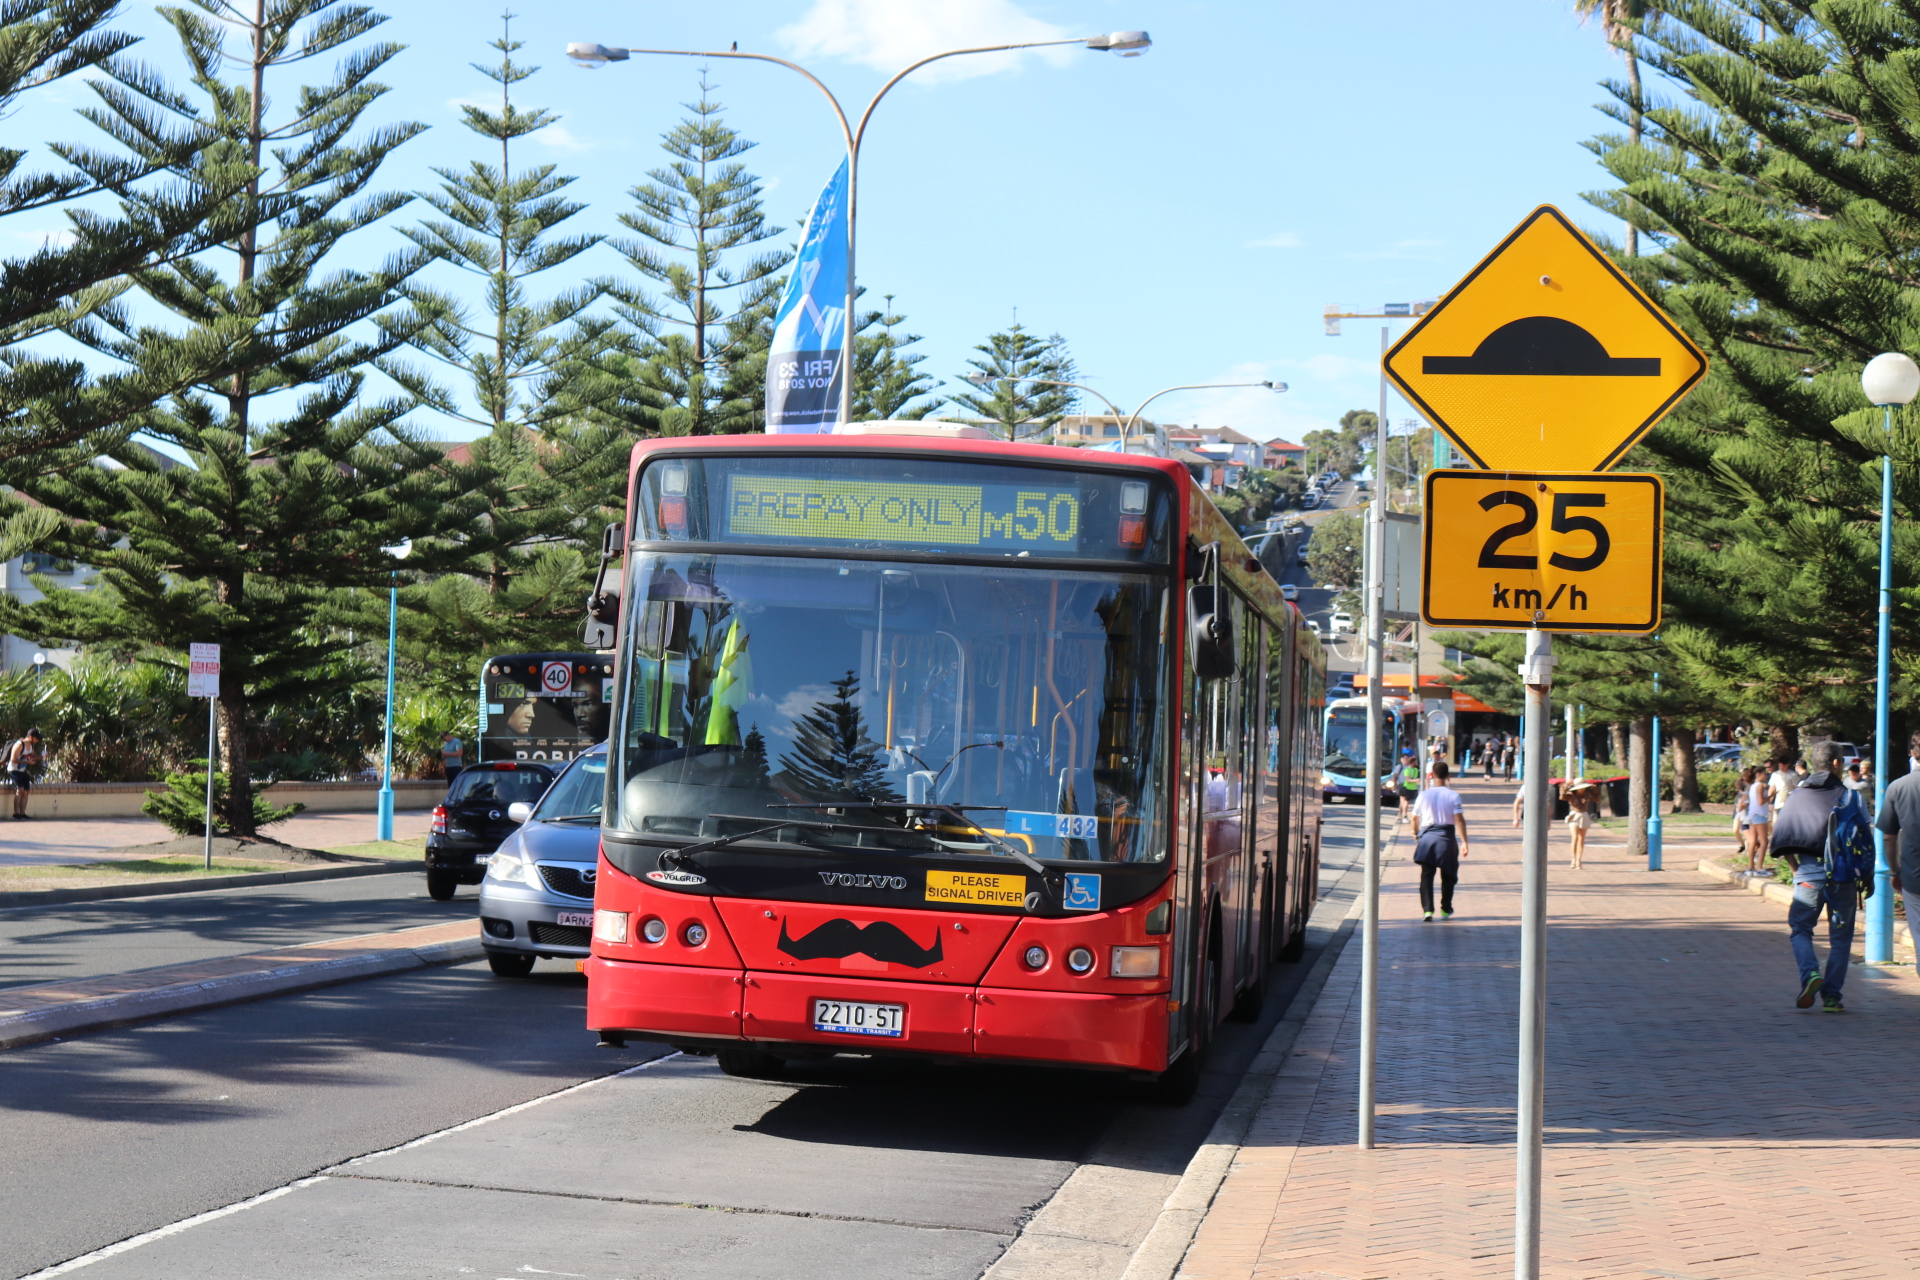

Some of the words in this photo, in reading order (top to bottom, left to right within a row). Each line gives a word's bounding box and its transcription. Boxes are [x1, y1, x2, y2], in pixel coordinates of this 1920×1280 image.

[1477, 490, 1611, 572] 25
[1492, 582, 1588, 611] km/h
[546, 669, 567, 684] 40
[498, 683, 525, 697] 373
[1021, 817, 1032, 832] L
[1059, 817, 1096, 837] 432
[663, 873, 703, 883] VOLGREN
[818, 871, 907, 890] VOLVO
[952, 875, 1000, 888] PLEASE
[928, 887, 974, 900] SIGNAL
[977, 890, 1023, 902] DRIVER
